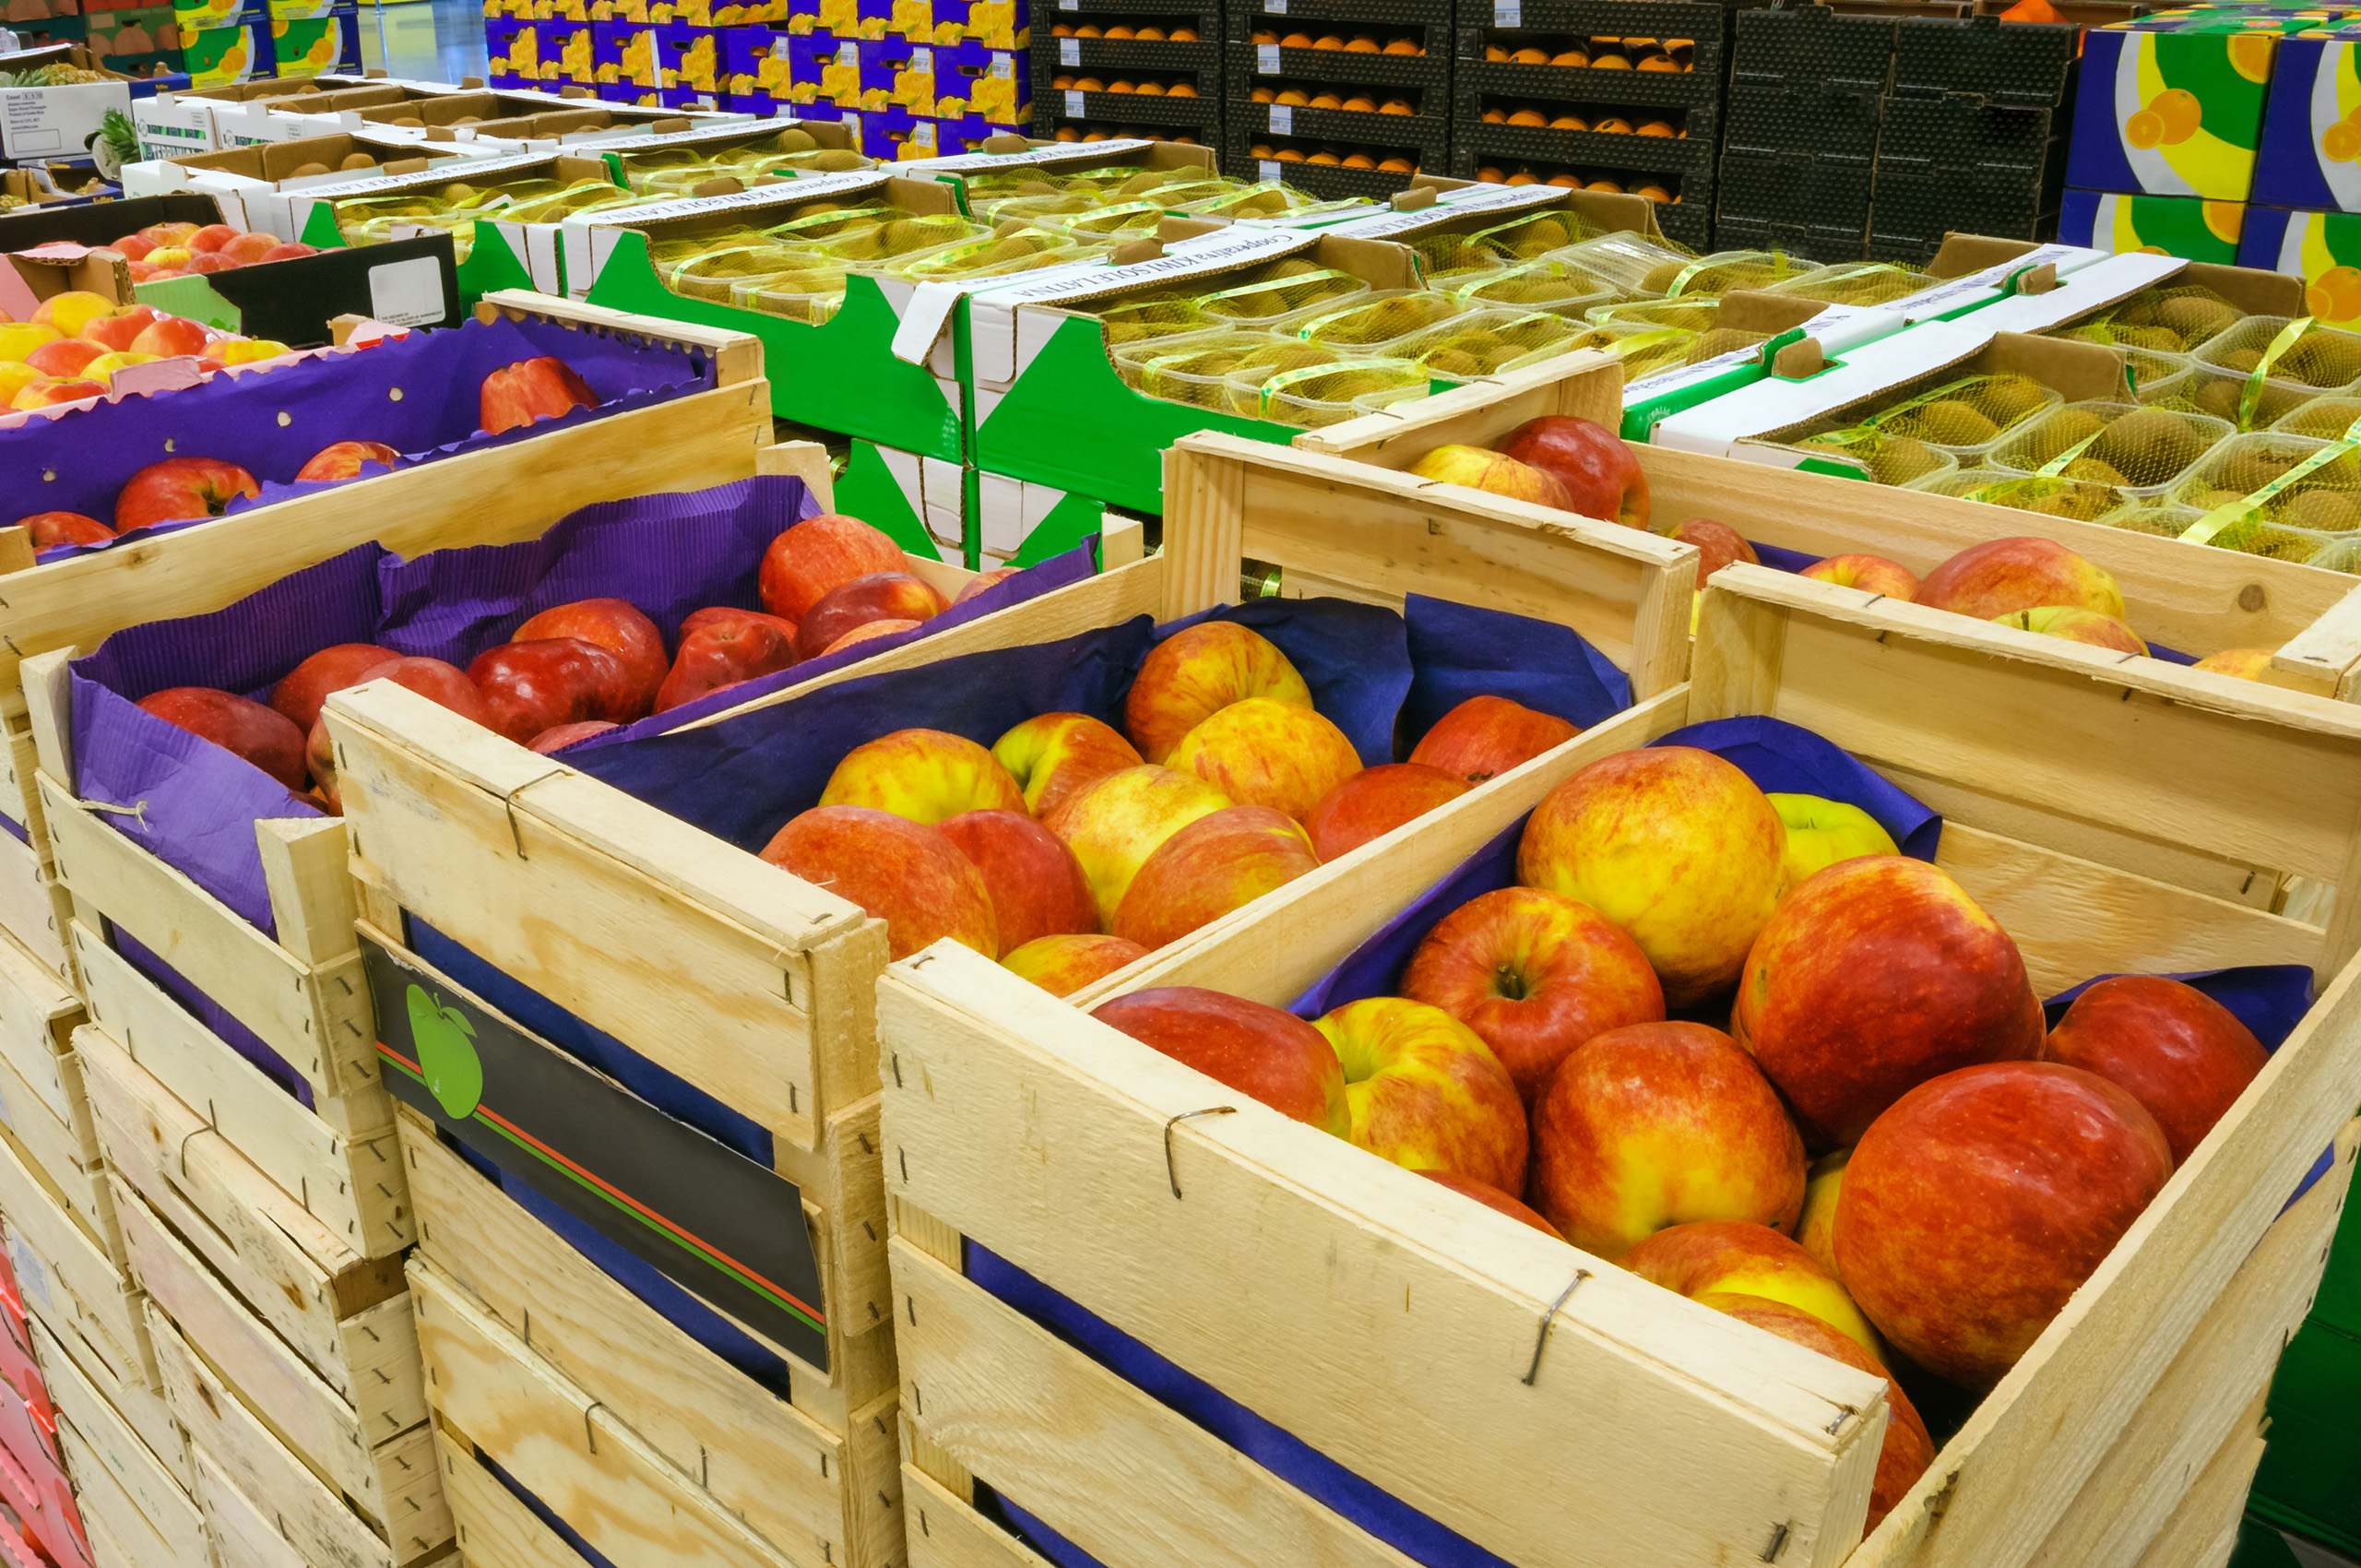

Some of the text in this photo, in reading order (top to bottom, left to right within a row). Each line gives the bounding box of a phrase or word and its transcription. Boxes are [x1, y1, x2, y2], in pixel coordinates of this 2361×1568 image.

[598, 176, 863, 220] Cooperativa KIWI SOLE LATINA
[1197, 234, 1293, 261] Cooperativa
[1097, 263, 1152, 282] SOLE
[1148, 255, 1201, 273] KIWI
[1011, 277, 1098, 298] LATINA
